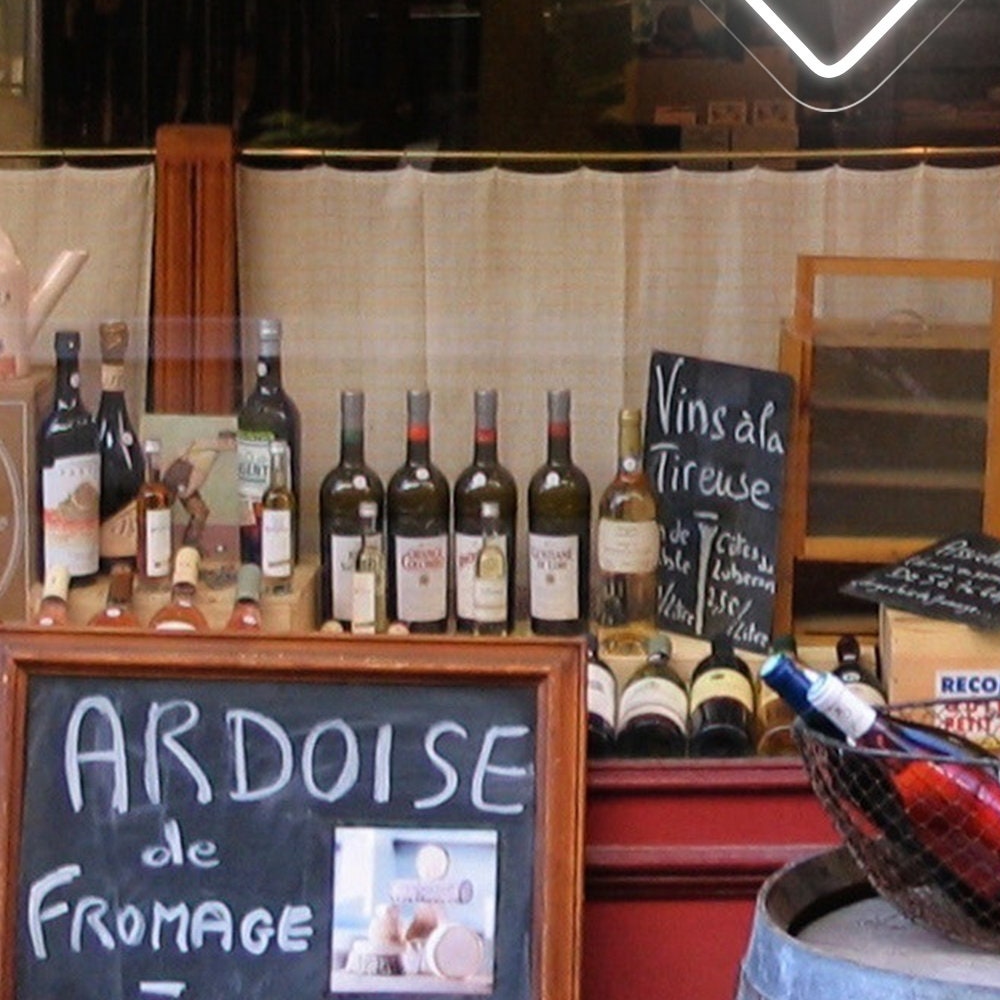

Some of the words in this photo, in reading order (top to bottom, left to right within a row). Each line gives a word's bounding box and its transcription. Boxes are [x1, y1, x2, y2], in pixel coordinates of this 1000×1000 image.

[655, 357, 727, 440] Vins
[734, 410, 756, 444] à
[759, 401, 785, 454] la
[650, 442, 773, 511] Tireuse
[65, 696, 535, 813] ARDOISE
[141, 820, 220, 869] de
[27, 864, 314, 959] FROMAGE
